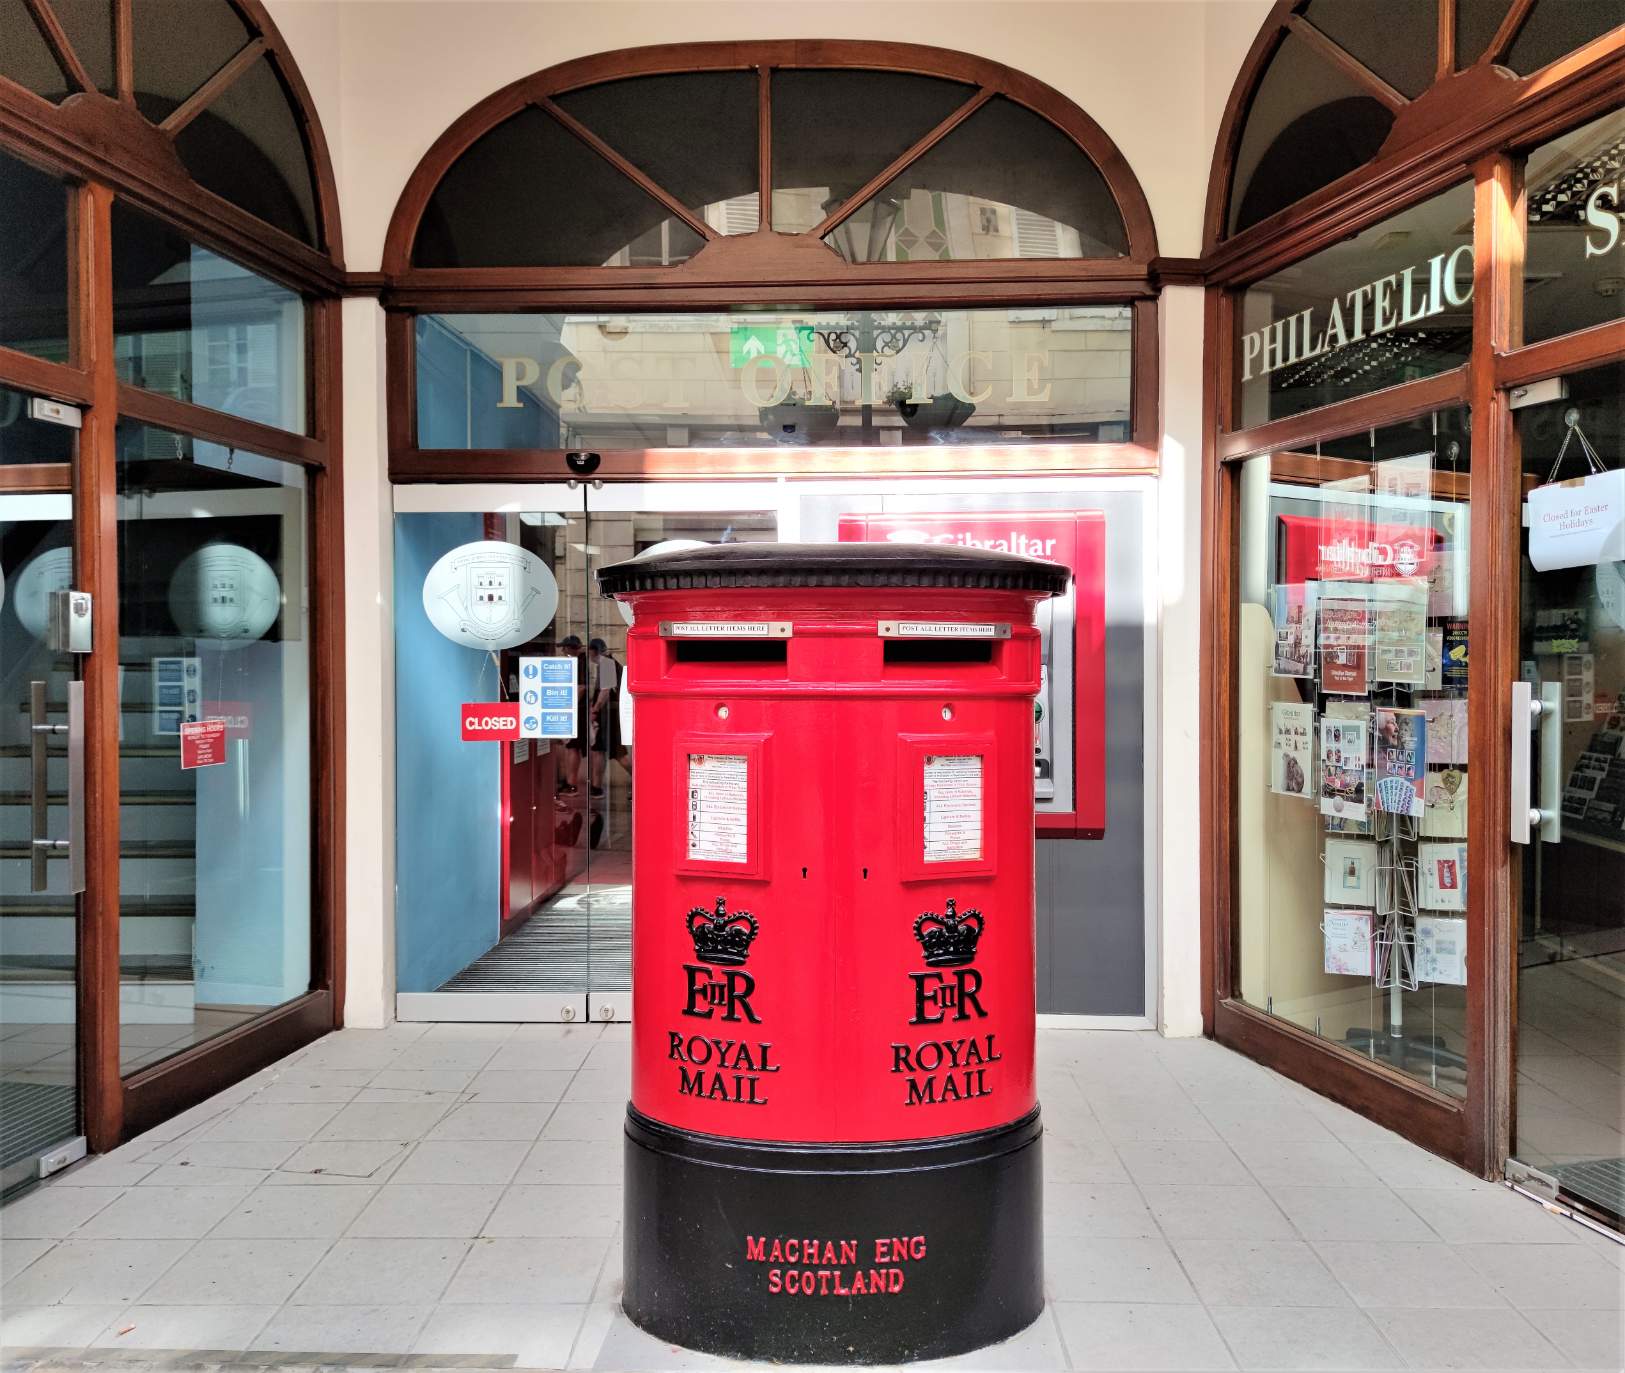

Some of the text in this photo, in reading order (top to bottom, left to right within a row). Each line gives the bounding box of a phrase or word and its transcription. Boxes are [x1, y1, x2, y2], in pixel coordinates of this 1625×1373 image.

[1241, 244, 1475, 383] PHILATELIC
[496, 352, 1053, 409] POST OFFICE
[1543, 503, 1609, 522] Closed for Easter
[1560, 517, 1593, 531] Holidays
[675, 624, 765, 632] POST ALL LETTER ITEMS HERE
[465, 716, 517, 730] CLOSED
[667, 1031, 780, 1073] ROYAL
[891, 1034, 1001, 1073] ROYAL
[678, 1066, 768, 1106] MAIL
[905, 1069, 993, 1106] MAIL
[746, 1235, 927, 1265] MACHAN ENG
[768, 1268, 905, 1296] SCOTLAND
